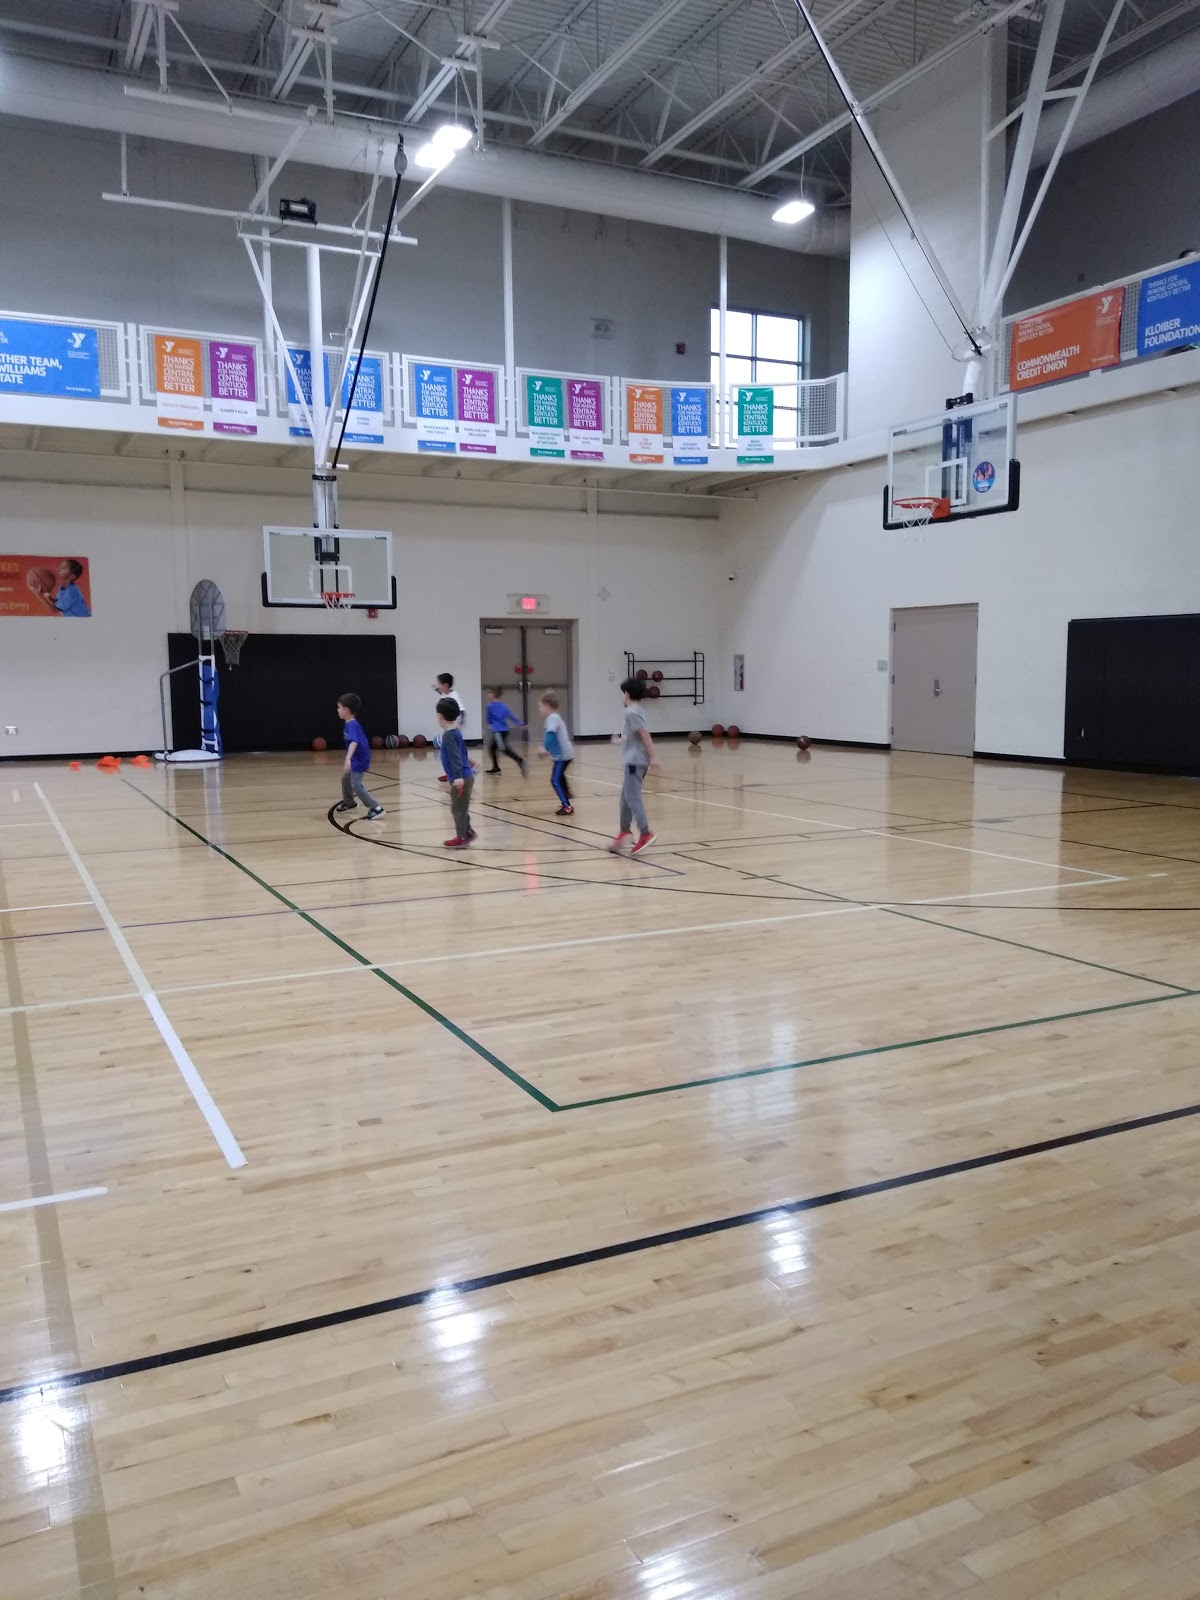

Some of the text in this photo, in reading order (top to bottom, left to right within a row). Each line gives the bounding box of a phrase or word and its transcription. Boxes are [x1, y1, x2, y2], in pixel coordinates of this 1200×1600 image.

[1145, 318, 1180, 337] KLOIBER
[1145, 325, 1200, 348] FOUNDATION
[0, 354, 62, 370] THER TEAM,
[163, 355, 194, 365] THANKS
[1017, 345, 1080, 371] COMMONWEALTH
[217, 361, 247, 371] THANKS
[1017, 359, 1067, 380] CREDIT UNION
[164, 368, 194, 377] CENTRAL
[218, 374, 247, 382] CENTRAL
[164, 382, 194, 392] BETTER
[218, 381, 247, 389] KENTUCKY
[348, 385, 374, 393] CNTRAL
[421, 383, 447, 391] THANKS
[219, 387, 248, 398] BETTER
[463, 387, 488, 395] THANKS
[464, 398, 488, 406] CENTRAL
[572, 396, 596, 404] THANKS
[422, 407, 448, 416] BETTER
[464, 411, 489, 420] BETTER
[534, 417, 558, 425] BETTER
